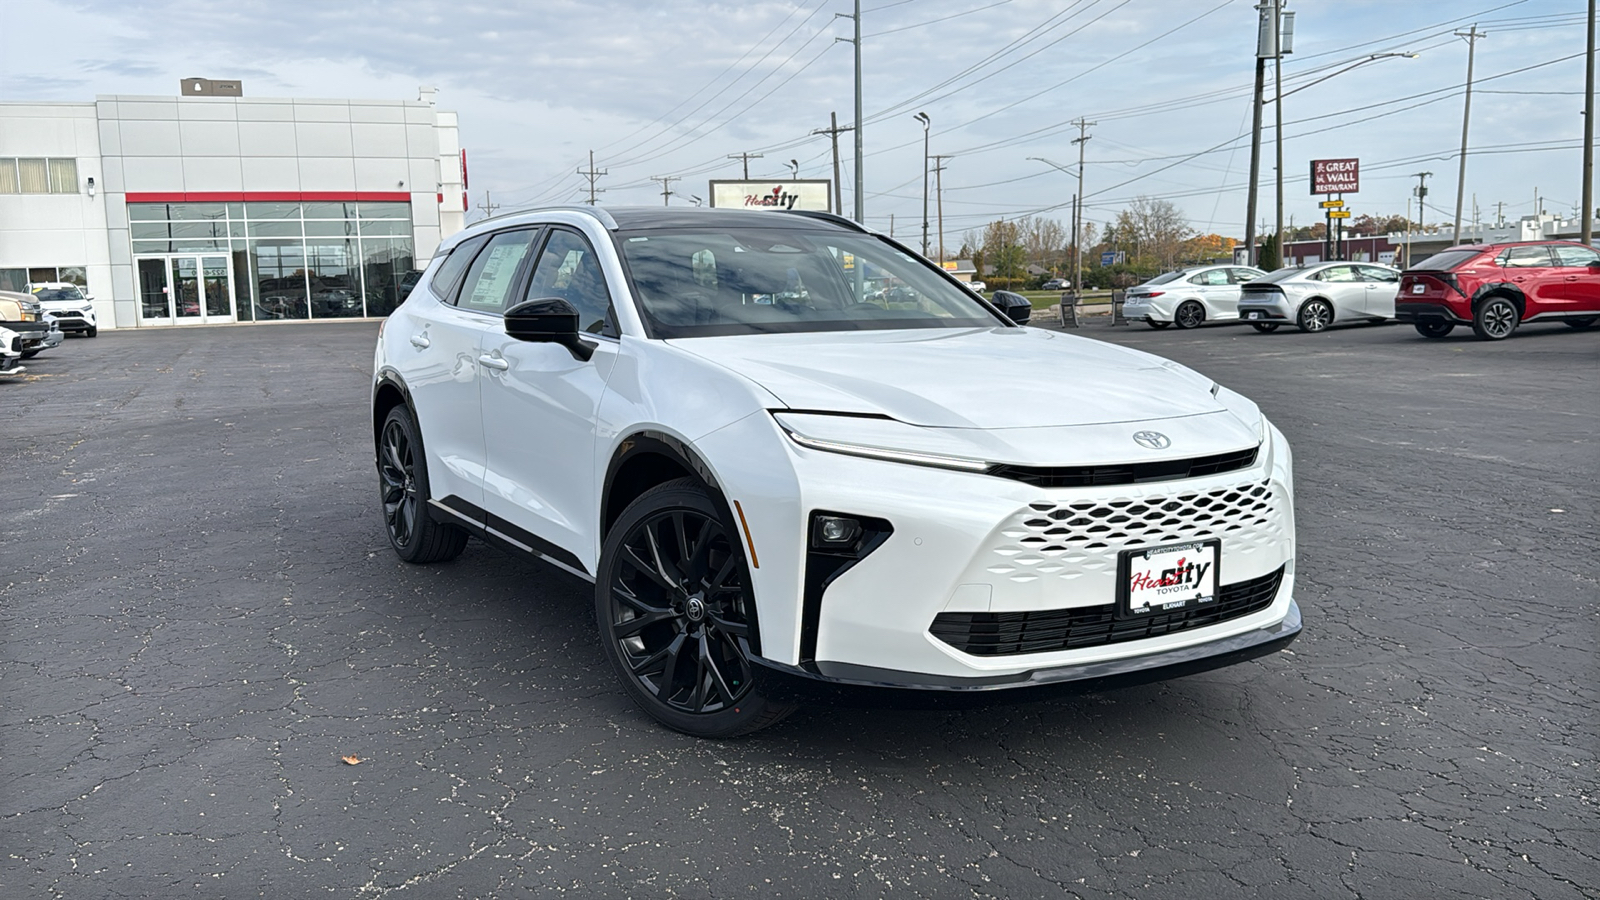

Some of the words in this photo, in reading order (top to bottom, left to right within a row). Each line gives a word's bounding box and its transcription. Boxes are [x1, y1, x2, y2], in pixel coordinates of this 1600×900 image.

[1326, 162, 1357, 172] GREAT
[1326, 172, 1355, 182] WALL
[1315, 183, 1357, 192] RESTAURANT
[744, 194, 782, 206] Heart
[1130, 568, 1189, 592] Heart
[1156, 585, 1190, 595] TOYOTA
[1162, 600, 1186, 610] ELKHART
